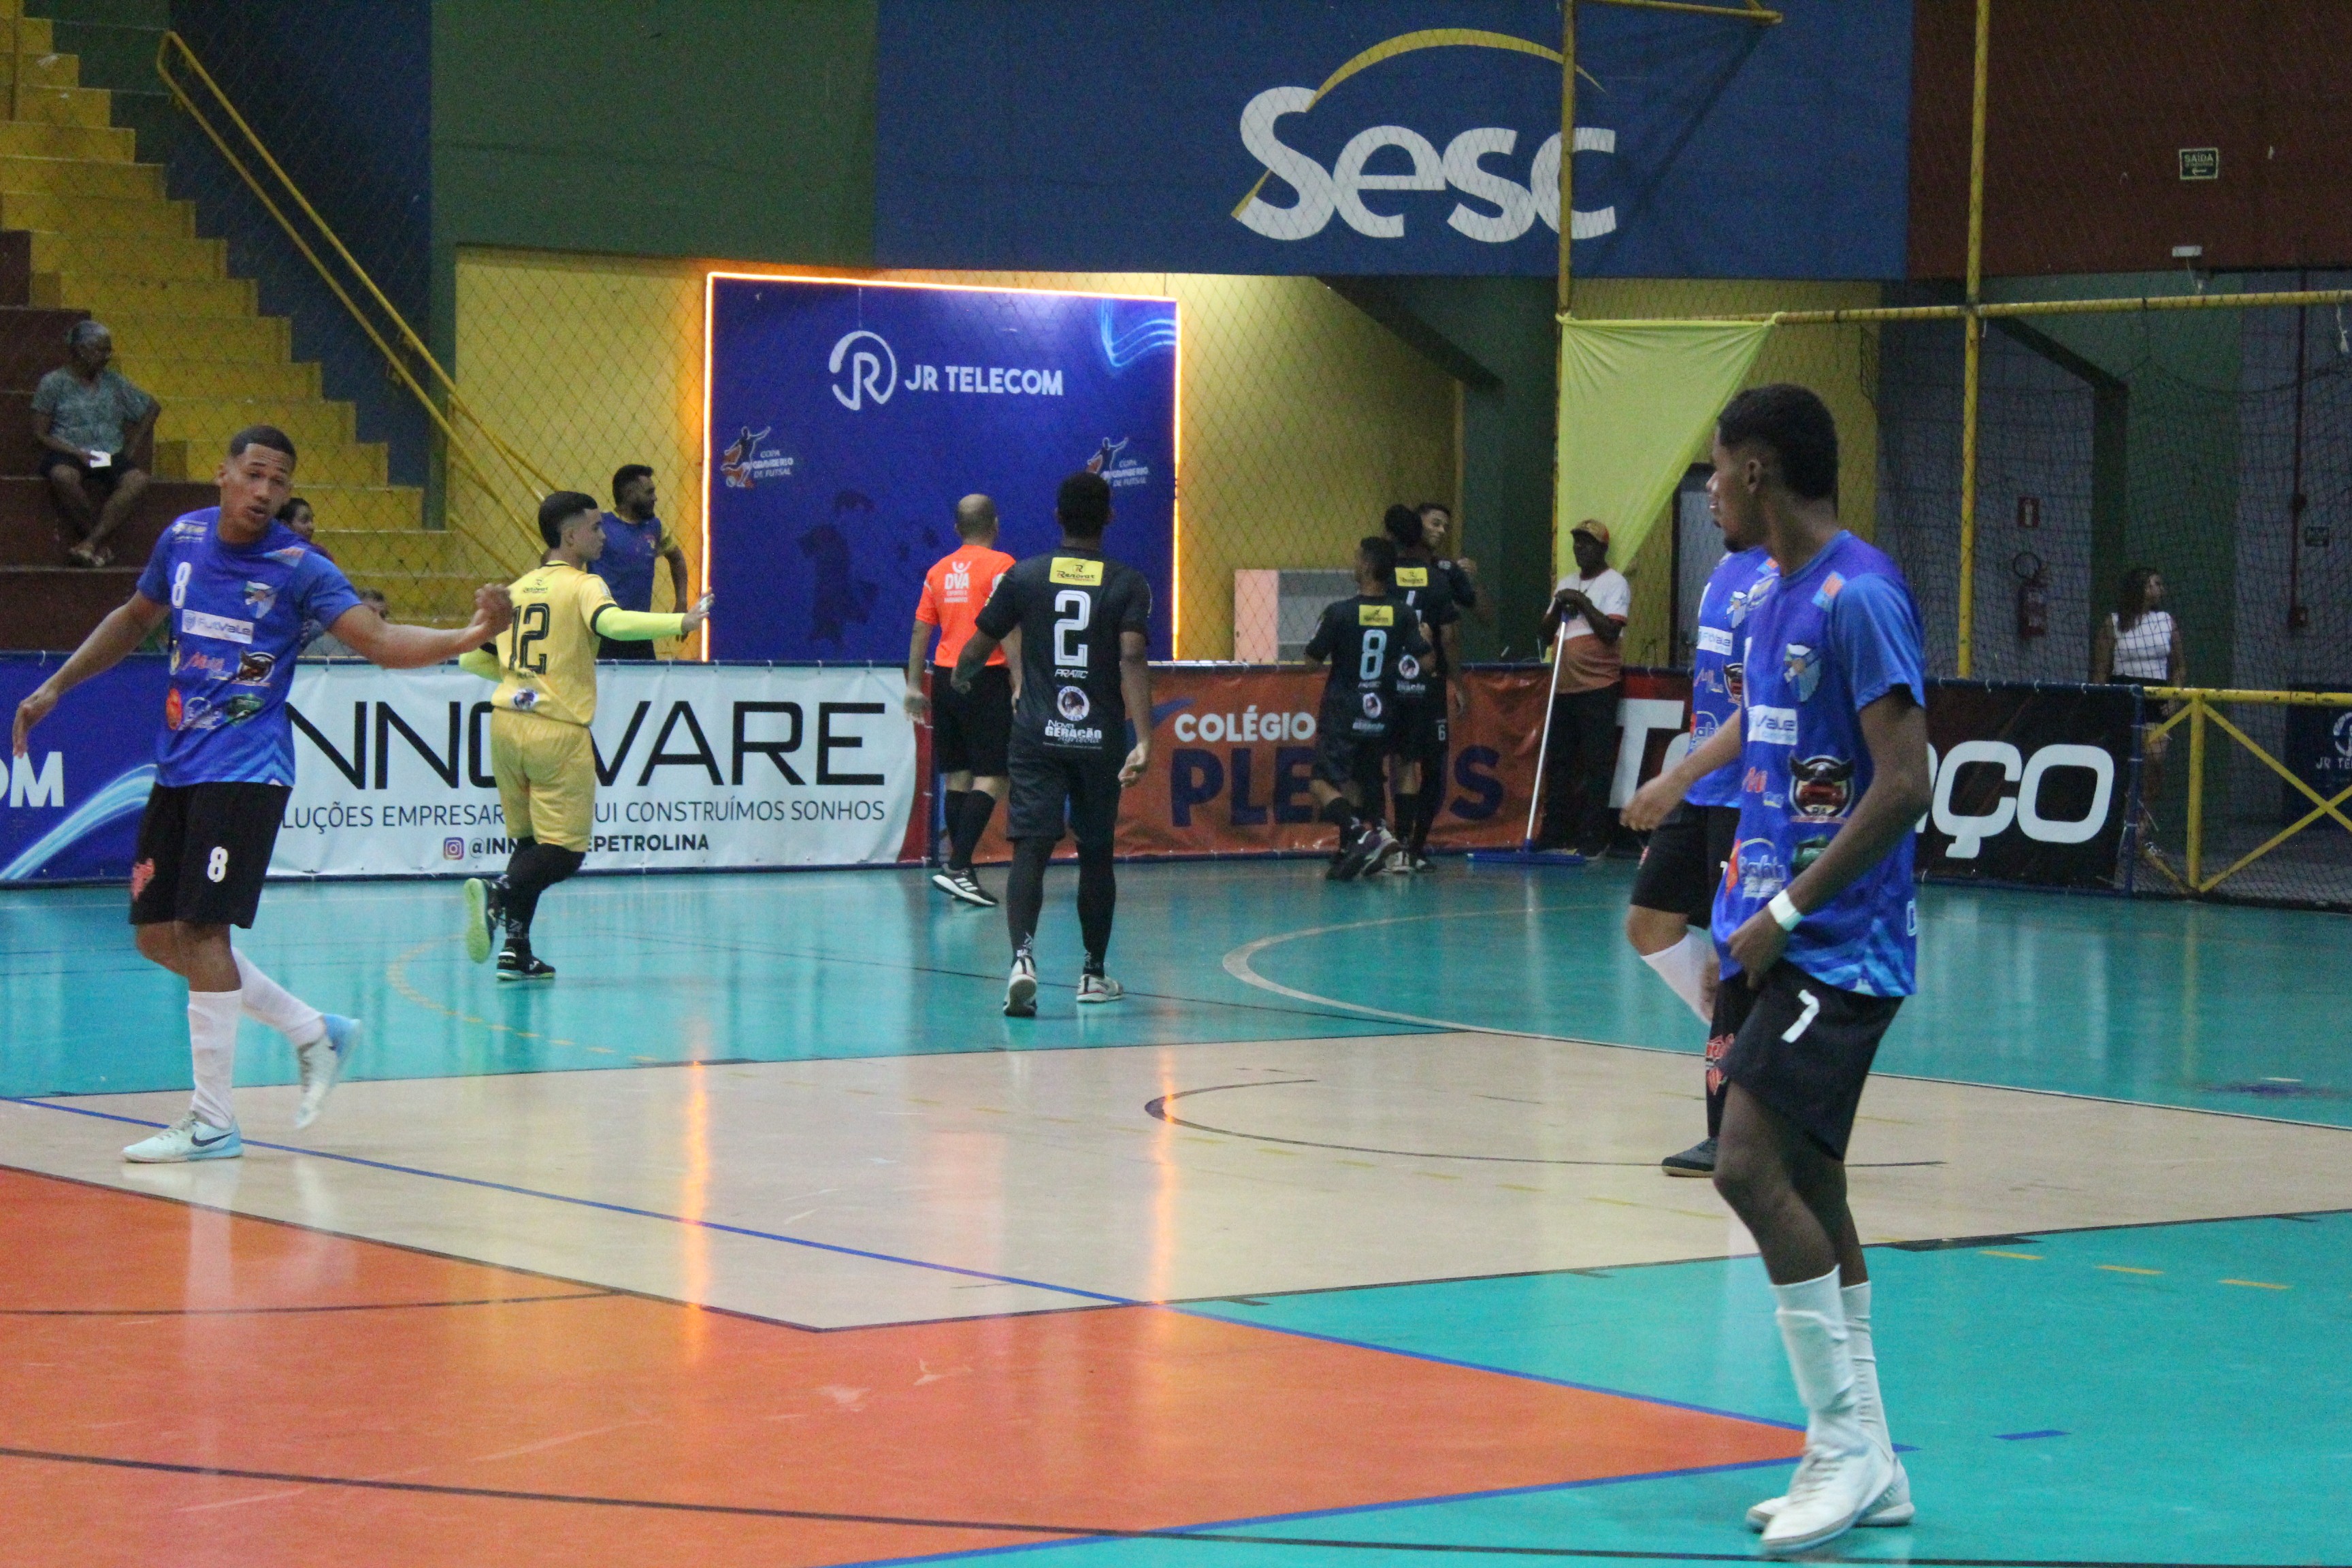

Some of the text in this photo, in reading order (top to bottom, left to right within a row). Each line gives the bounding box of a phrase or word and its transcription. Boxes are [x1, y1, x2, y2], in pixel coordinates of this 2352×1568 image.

[1235, 86, 1616, 242] Sesc
[904, 365, 1063, 396] JR TELECOM
[760, 450, 781, 458] COPA
[172, 561, 192, 609] 8
[944, 573, 969, 589] DVA
[508, 603, 550, 674] 12
[1054, 589, 1091, 667] 2
[1360, 629, 1387, 681] 8
[1048, 719, 1074, 729] Nova
[1174, 704, 1317, 742] COLÉGIO
[1438, 725, 1446, 741] 6
[284, 700, 885, 789] NNVARE
[2316, 757, 2352, 770] JR TE
[1170, 745, 1504, 828] PLES
[282, 796, 885, 834] LUÇÕES EMPRESAR UI CONSTRUÍMOS SONHOS
[207, 846, 229, 883] 8
[1781, 990, 1820, 1043] 7
